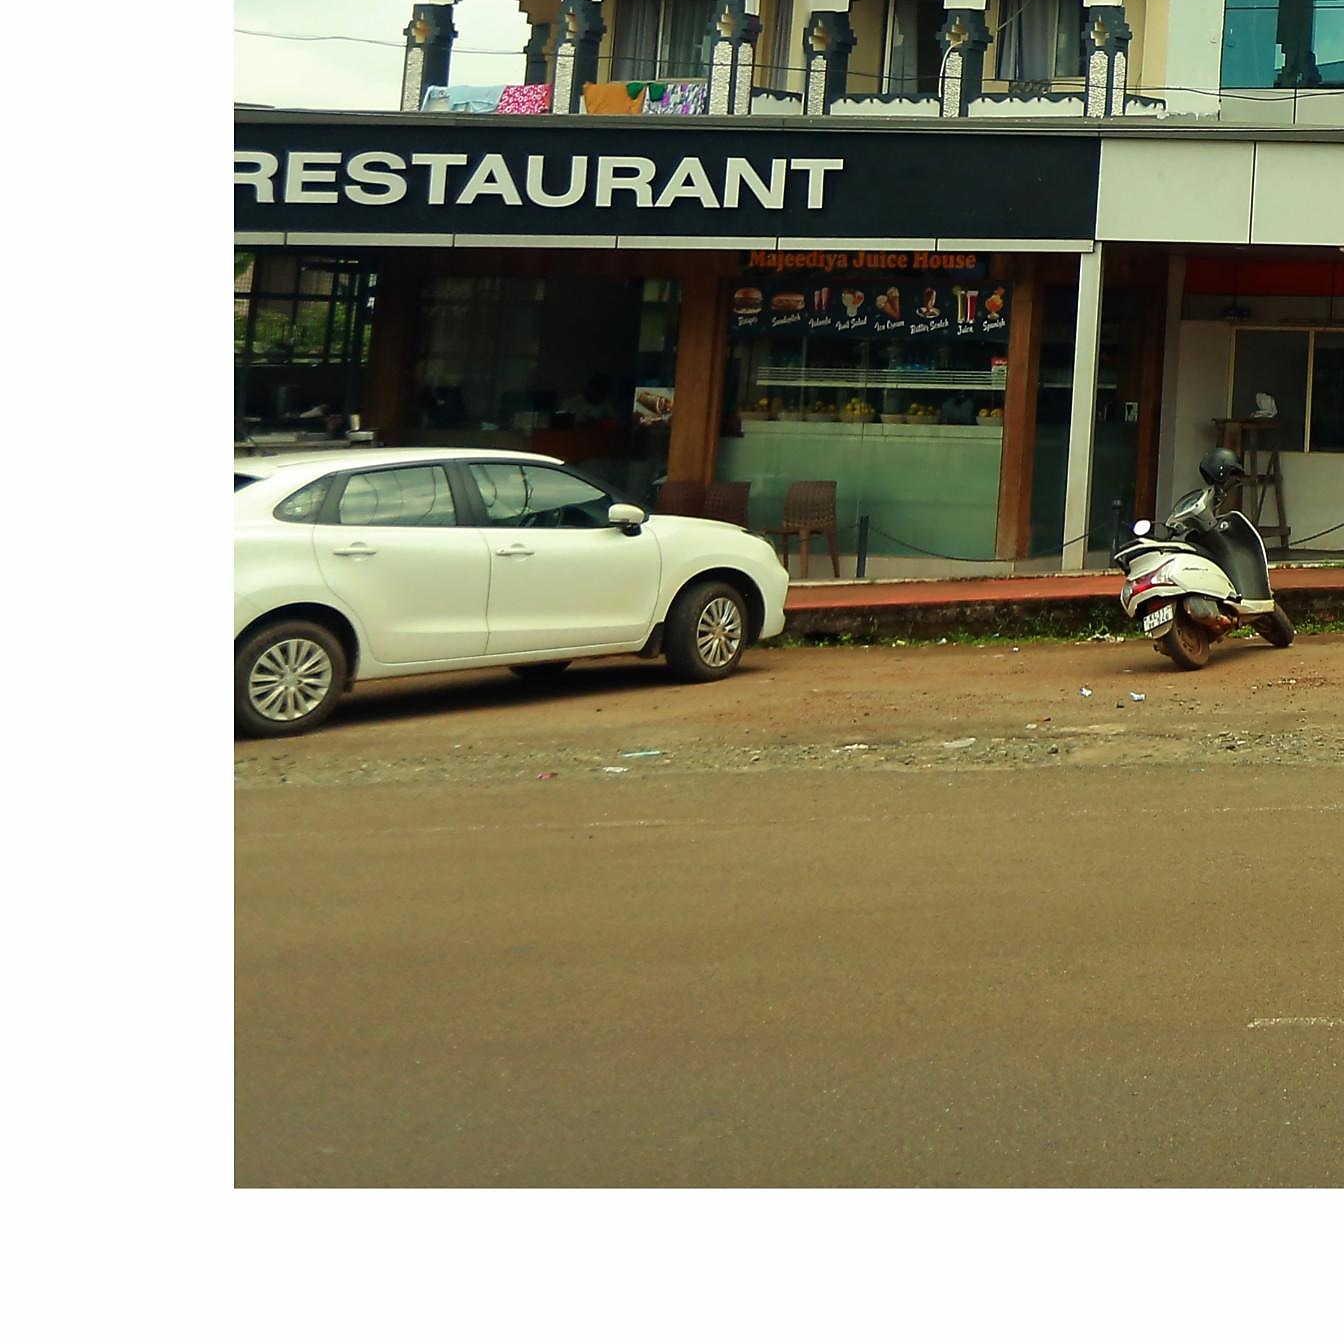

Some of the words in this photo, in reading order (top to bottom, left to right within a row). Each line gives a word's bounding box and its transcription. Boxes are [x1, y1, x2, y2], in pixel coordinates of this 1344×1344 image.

[234, 150, 844, 209] RESTAURANT
[749, 250, 849, 272] Majeediya
[852, 251, 909, 269] Juice
[912, 251, 978, 269] House
